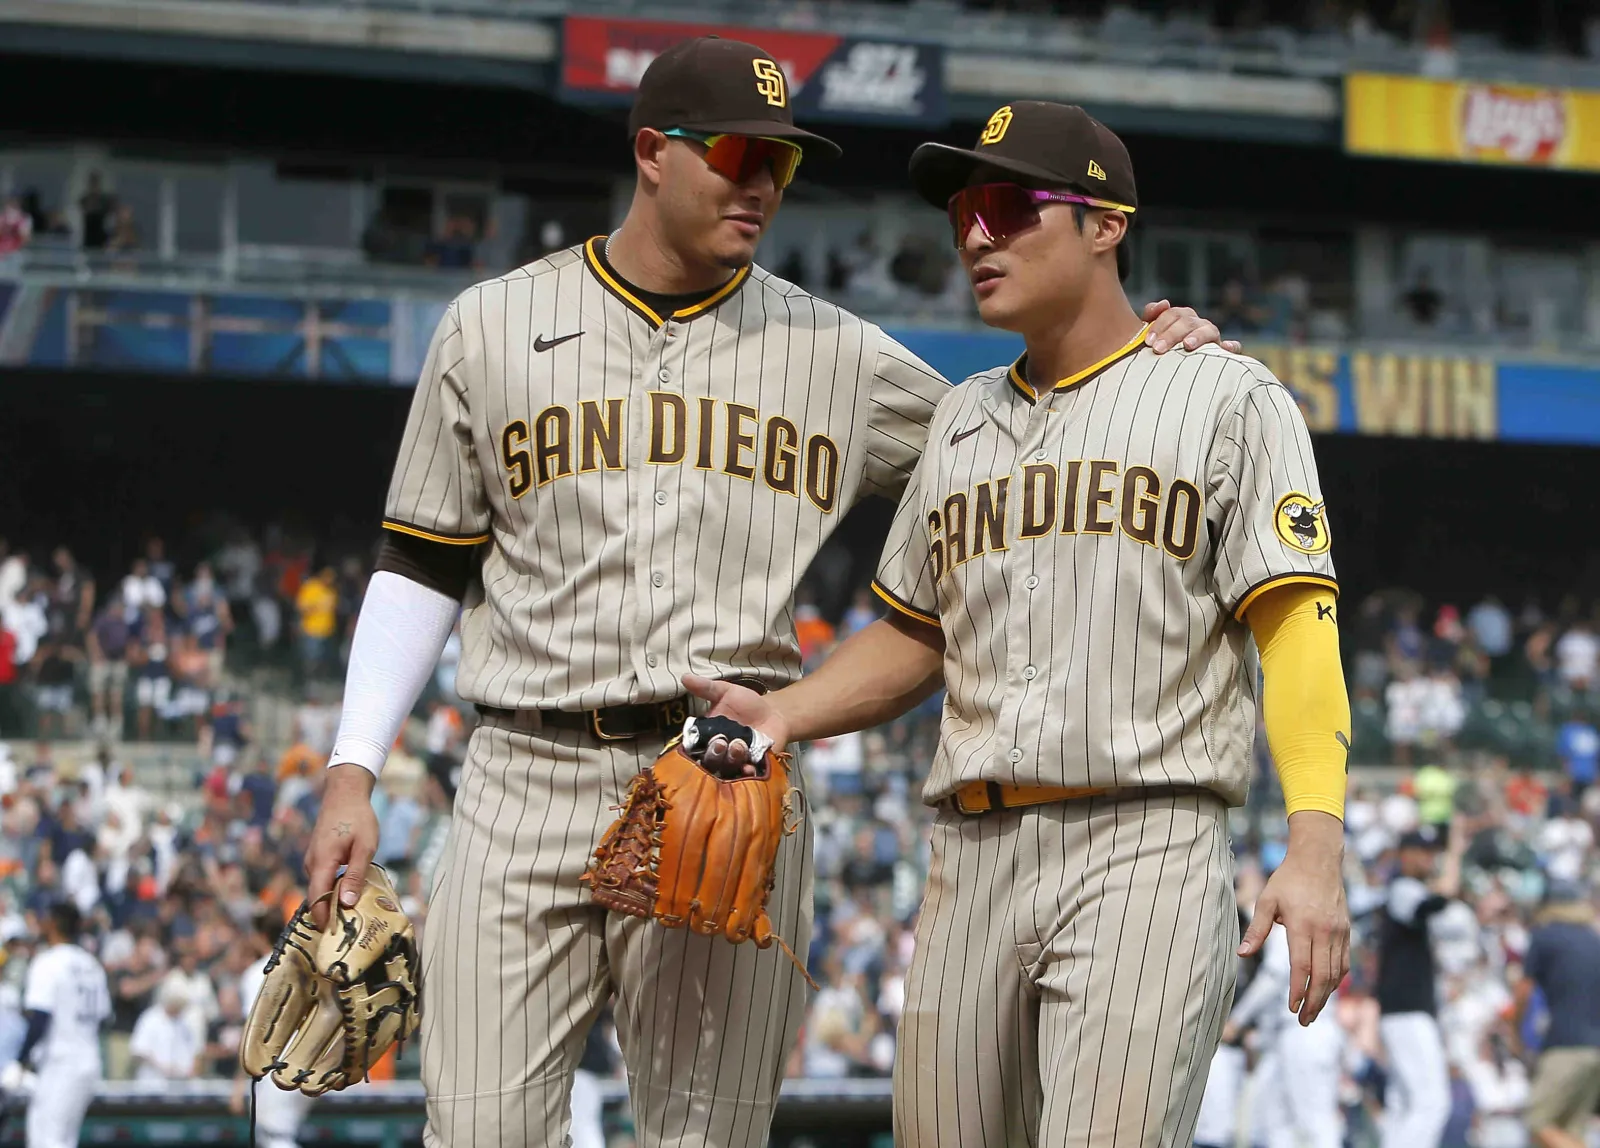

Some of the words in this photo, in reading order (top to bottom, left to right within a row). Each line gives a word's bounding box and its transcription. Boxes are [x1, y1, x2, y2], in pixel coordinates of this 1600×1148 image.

[1354, 354, 1496, 437] WIN
[502, 397, 627, 500] SAN
[644, 390, 840, 515] DIEGO
[927, 475, 1013, 586] SAN
[1017, 458, 1203, 561] DIEGO
[661, 702, 685, 724] 13
